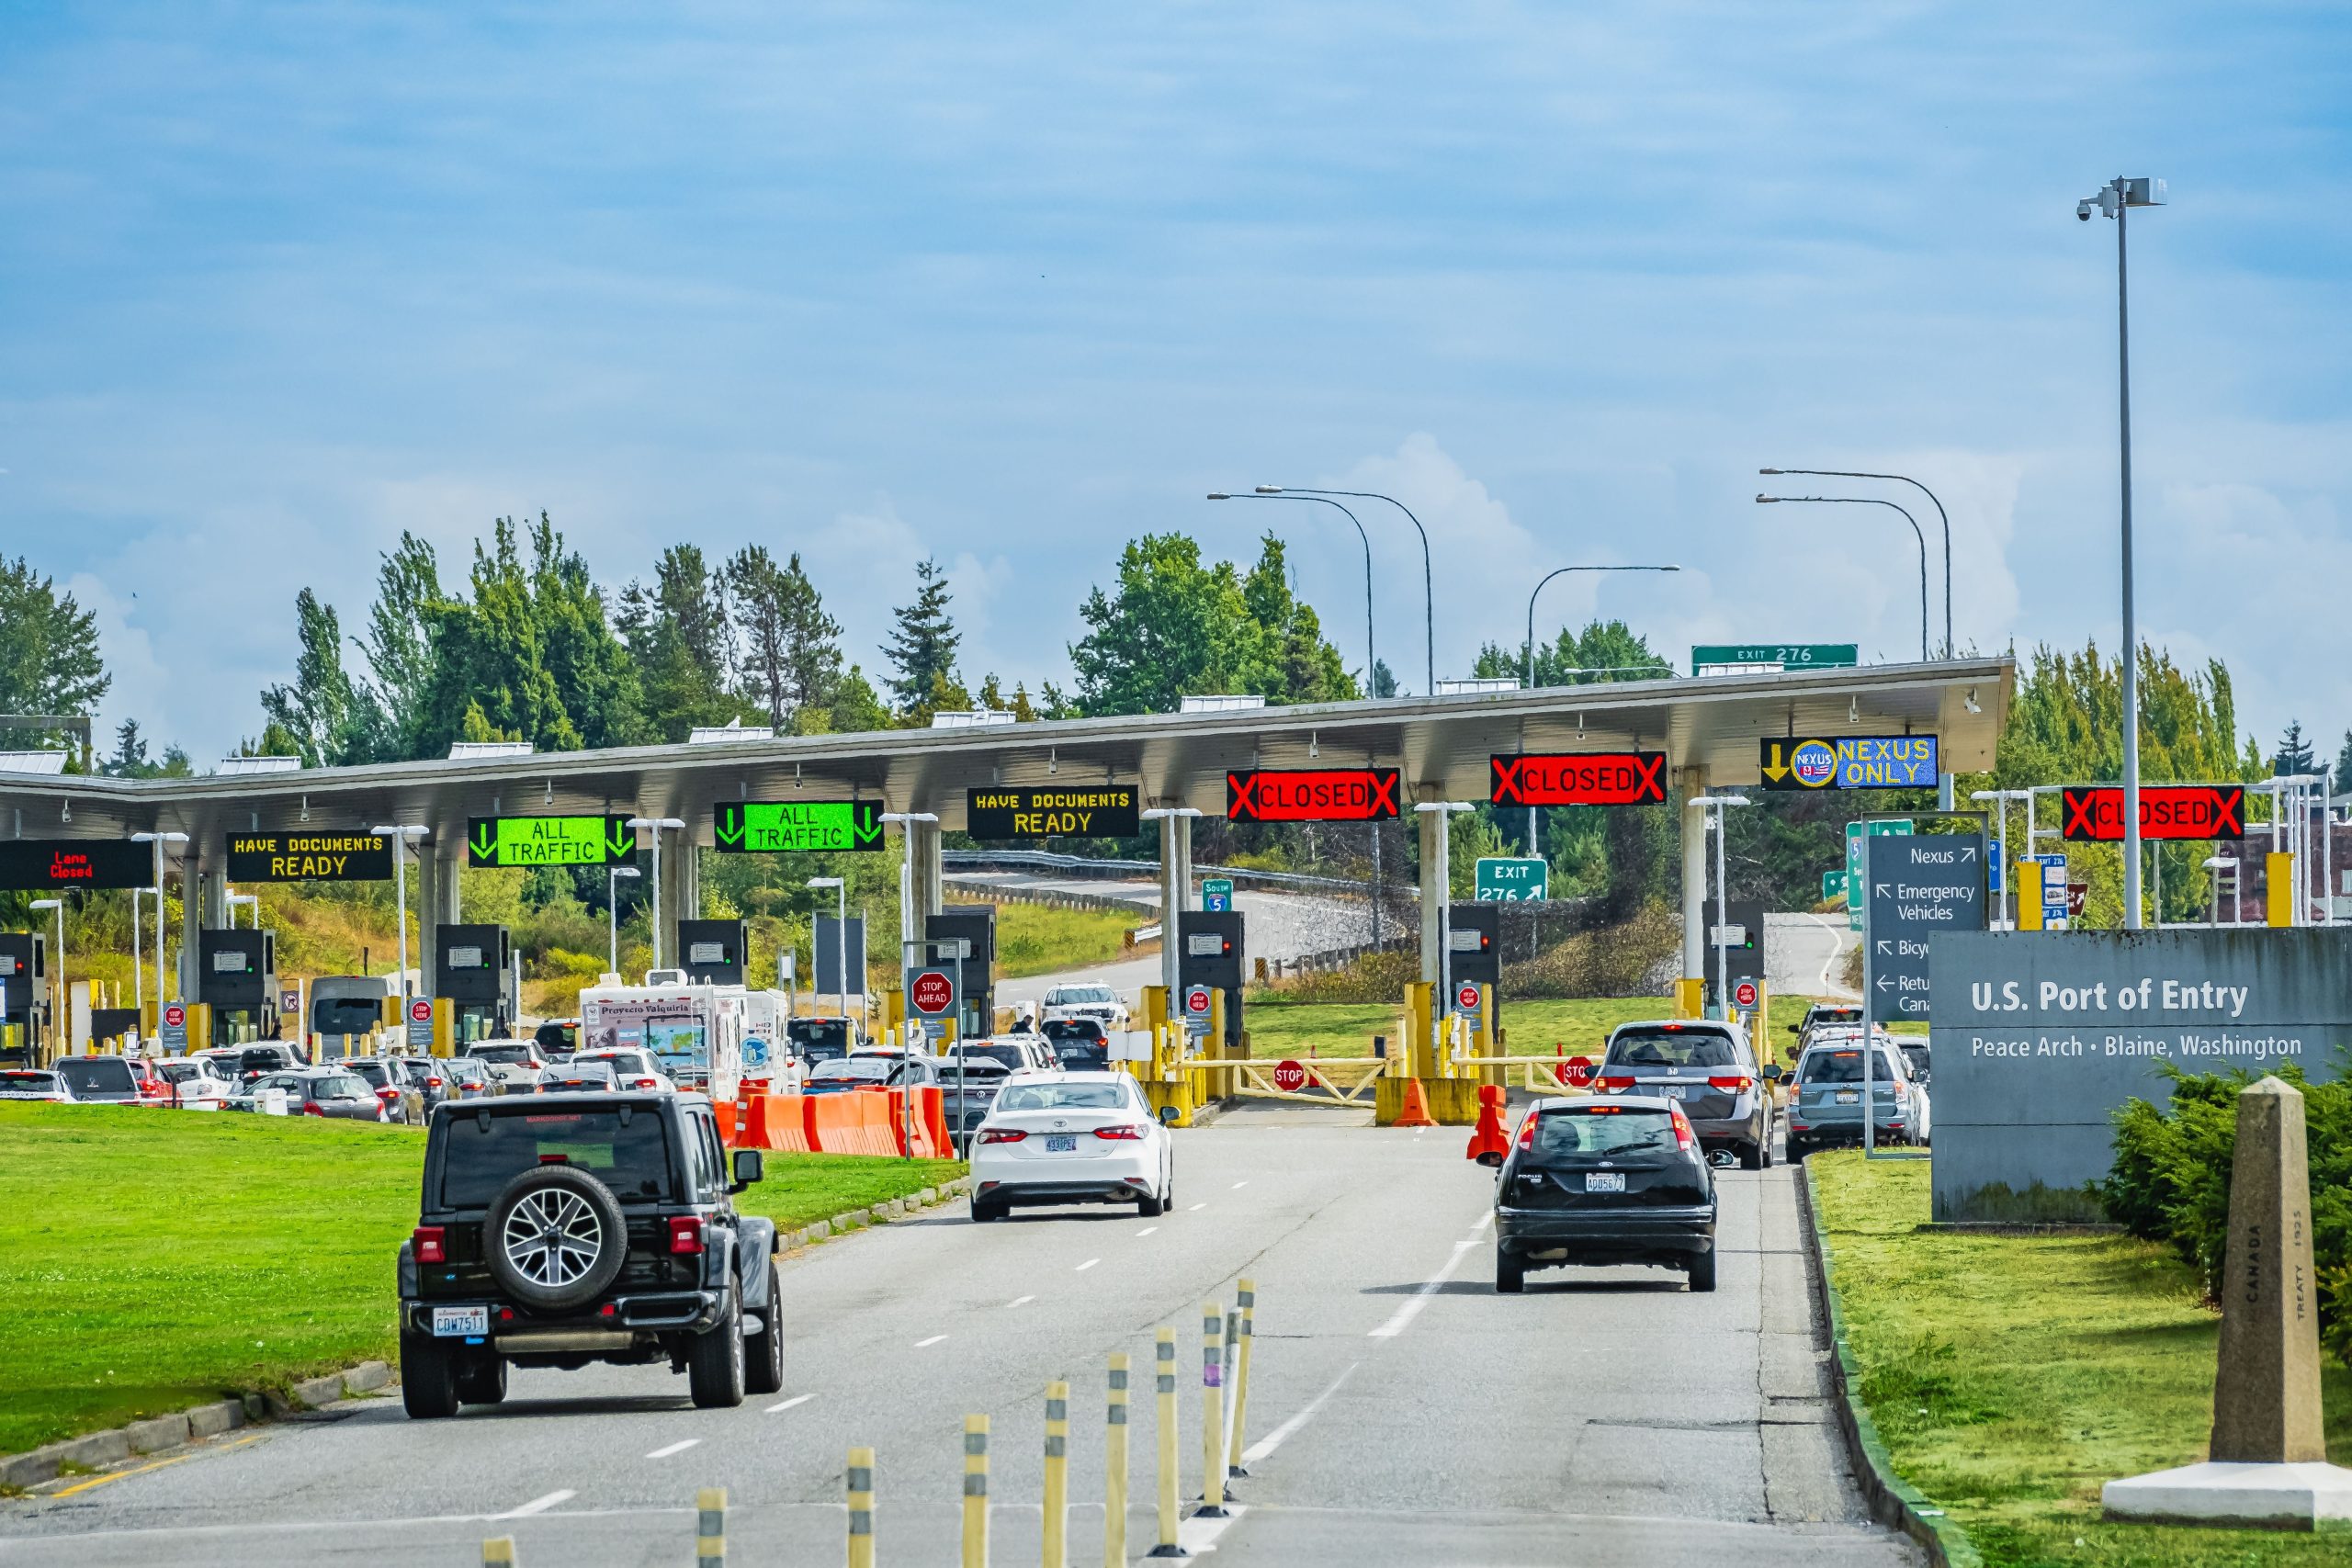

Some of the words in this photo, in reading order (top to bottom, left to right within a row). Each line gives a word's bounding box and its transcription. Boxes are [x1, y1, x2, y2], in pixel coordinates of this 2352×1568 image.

[1737, 650, 1765, 660] EXIT
[1776, 648, 1812, 661] 276
[1838, 739, 1929, 761] NEXUS
[1796, 753, 1832, 765] NEXUS
[1524, 767, 1632, 792] CLOSED
[1847, 763, 1920, 784] ONLY
[977, 795, 1020, 808] HAVE
[1033, 793, 1129, 807] DOCUMENTS
[1260, 783, 1366, 807] CLOSED
[779, 807, 818, 825] ALL
[2098, 801, 2209, 825] CLOSED
[532, 821, 570, 840] ALL
[1014, 812, 1092, 833] READY
[234, 839, 277, 852] HAVE
[288, 837, 383, 852] DOCUMENTS
[756, 828, 842, 847] TRAFFIC
[55, 852, 87, 864] Lane
[509, 841, 594, 861] TRAFFIC
[1911, 848, 1954, 863] Nexus
[51, 864, 93, 878] Closed
[272, 855, 347, 876] READY
[1495, 866, 1530, 879] EXIT
[1480, 887, 1518, 901] 276
[1897, 884, 1975, 903] Emergency
[1213, 898, 1222, 911] 5
[1897, 904, 1953, 920] Vehicles
[922, 982, 943, 992] STOP
[918, 993, 947, 1003] AHEAD
[1972, 981, 2029, 1011] U.S.
[2040, 981, 2108, 1011] Port
[2118, 977, 2153, 1010] of
[2162, 979, 2248, 1018] Entry
[602, 1006, 644, 1015] Proyecto
[645, 1004, 689, 1014] Valquiria
[1972, 1037, 2030, 1057] Peace
[2037, 1035, 2083, 1057] Arch
[2105, 1034, 2173, 1058] Blaine,
[2180, 1033, 2301, 1061] Washington
[1276, 1069, 1303, 1082] STOP
[1566, 1066, 1586, 1078] STO
[2293, 1210, 2301, 1247] 1925
[2246, 1224, 2261, 1303] CANADA
[2294, 1265, 2305, 1321] TREATY
[436, 1316, 483, 1332] CDW7511
